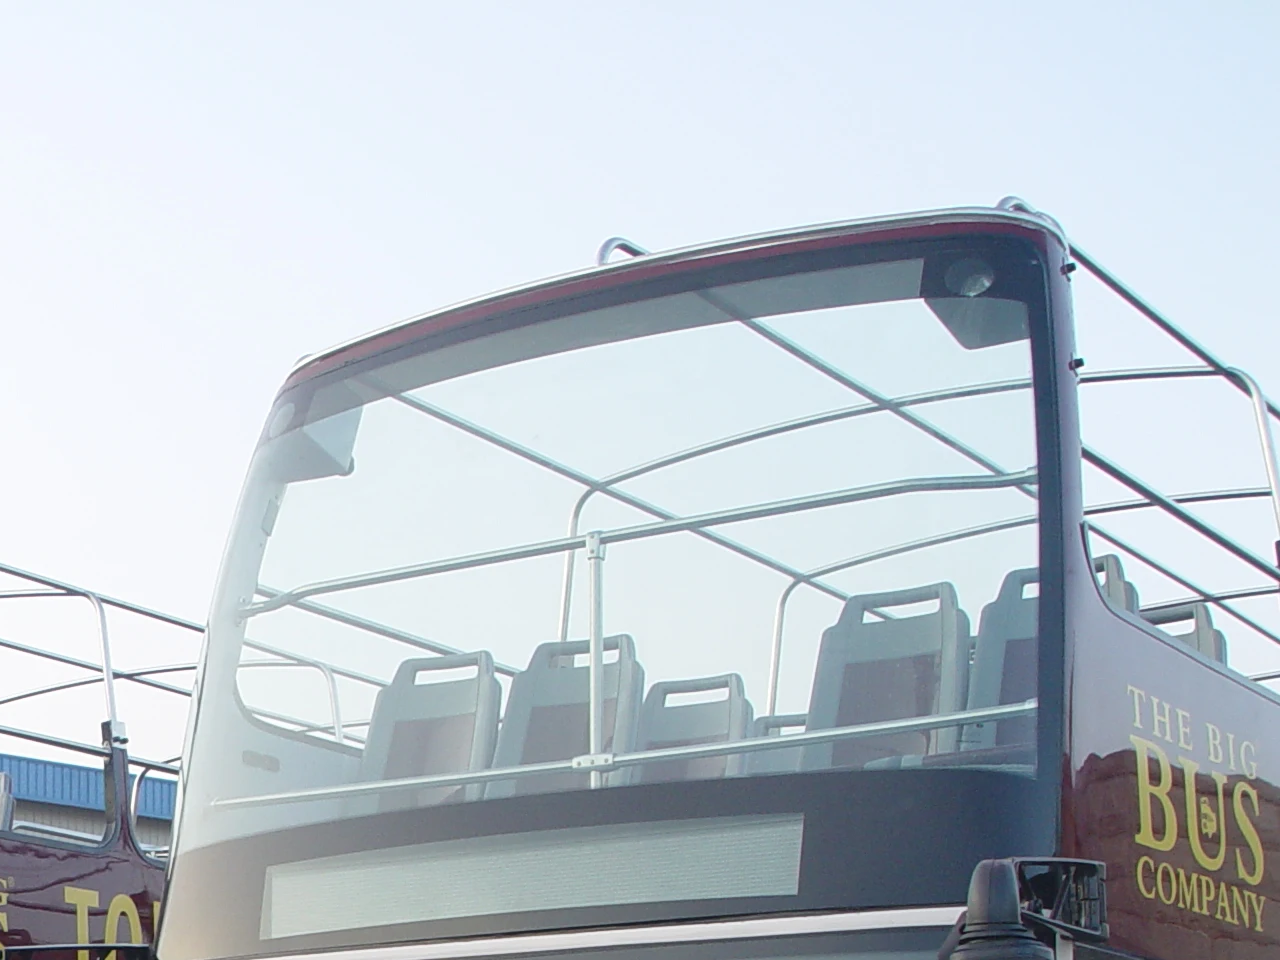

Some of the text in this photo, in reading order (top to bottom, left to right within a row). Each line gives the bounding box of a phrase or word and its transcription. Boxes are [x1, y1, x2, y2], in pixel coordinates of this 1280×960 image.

[1127, 684, 1257, 779] THE BIG
[1129, 734, 1264, 886] BUS
[1136, 856, 1266, 932] COMPANY
